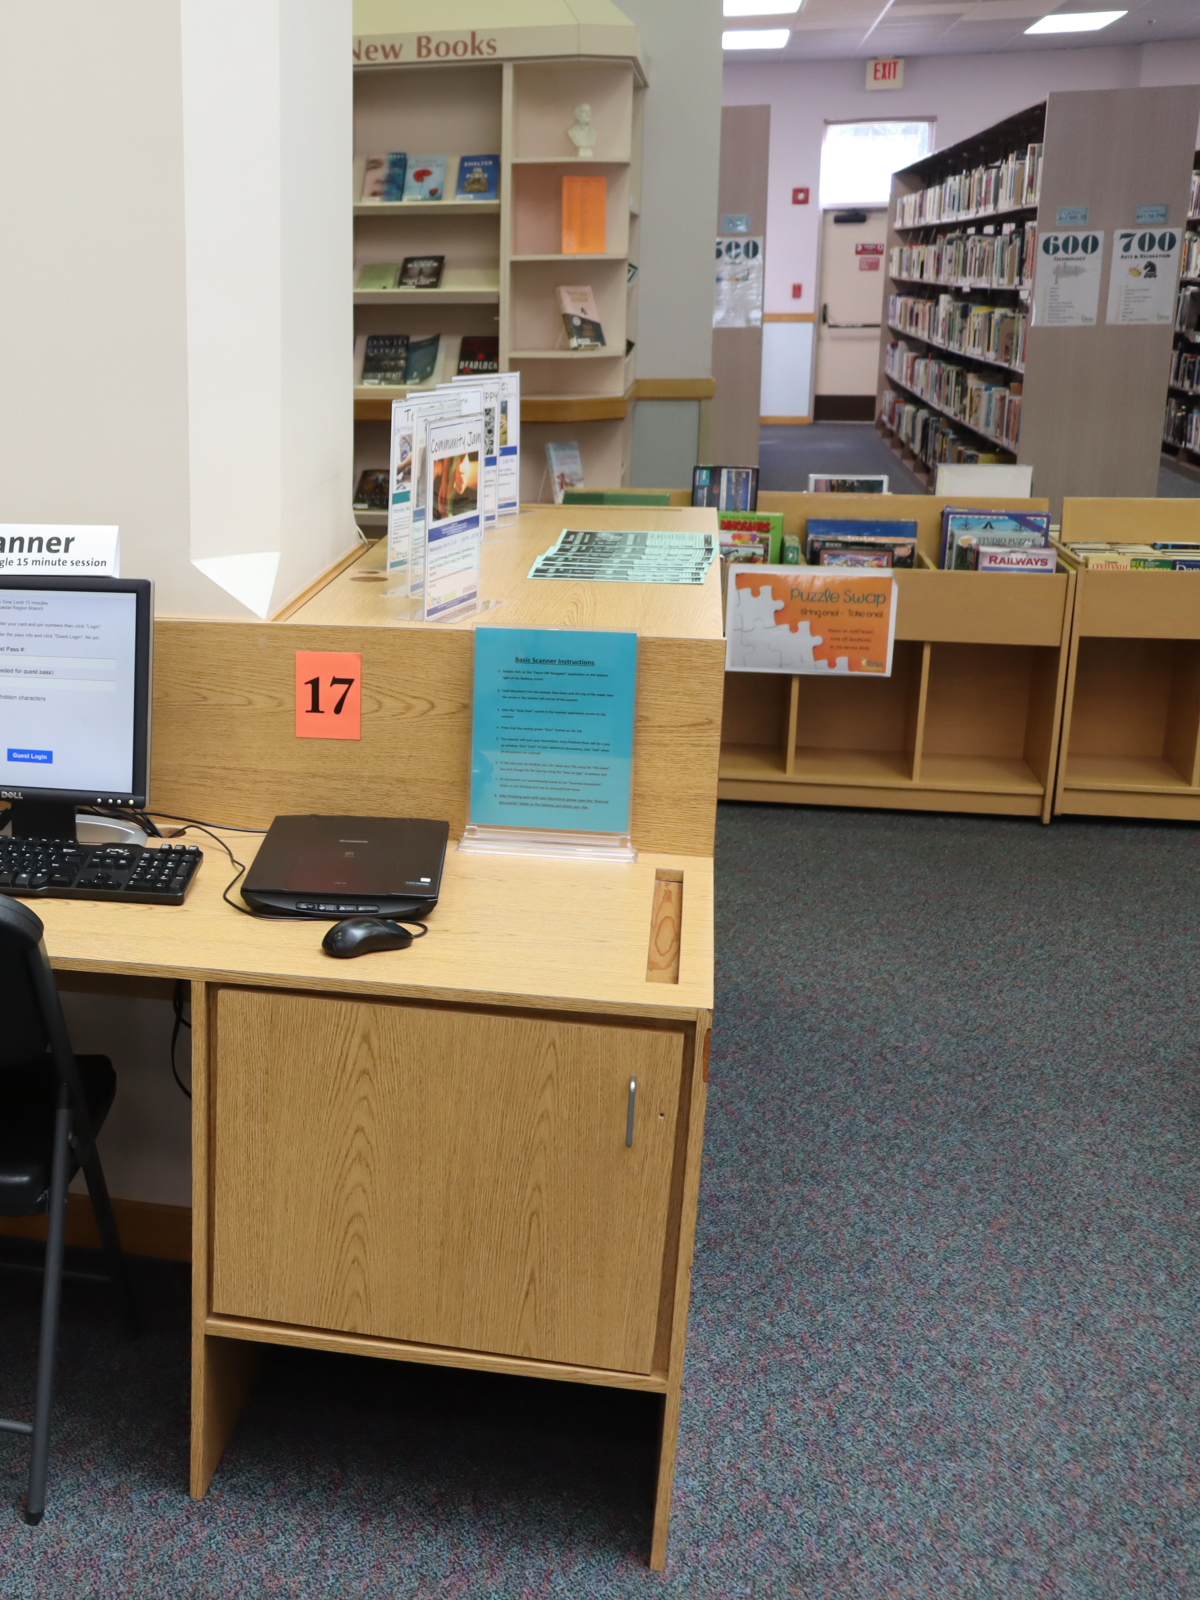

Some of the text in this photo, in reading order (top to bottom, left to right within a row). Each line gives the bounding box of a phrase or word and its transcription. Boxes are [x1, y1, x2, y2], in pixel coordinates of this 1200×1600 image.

[416, 31, 498, 58] Books
[873, 60, 899, 80] EXIT
[1042, 234, 1099, 255] 600
[1118, 231, 1177, 253] 700
[431, 431, 481, 454] Community Jam
[721, 519, 770, 533] DINOSAURS
[978, 537, 1006, 545] STUDIO
[17, 558, 28, 566] 15
[32, 558, 68, 567] minute
[70, 558, 107, 567] session
[989, 556, 1048, 566] RAILWAYS
[790, 588, 886, 607] Puzzle Swap
[800, 608, 822, 618] Bring
[848, 609, 865, 617] Take
[304, 675, 355, 715] 17
[1, 791, 23, 799] DELL
